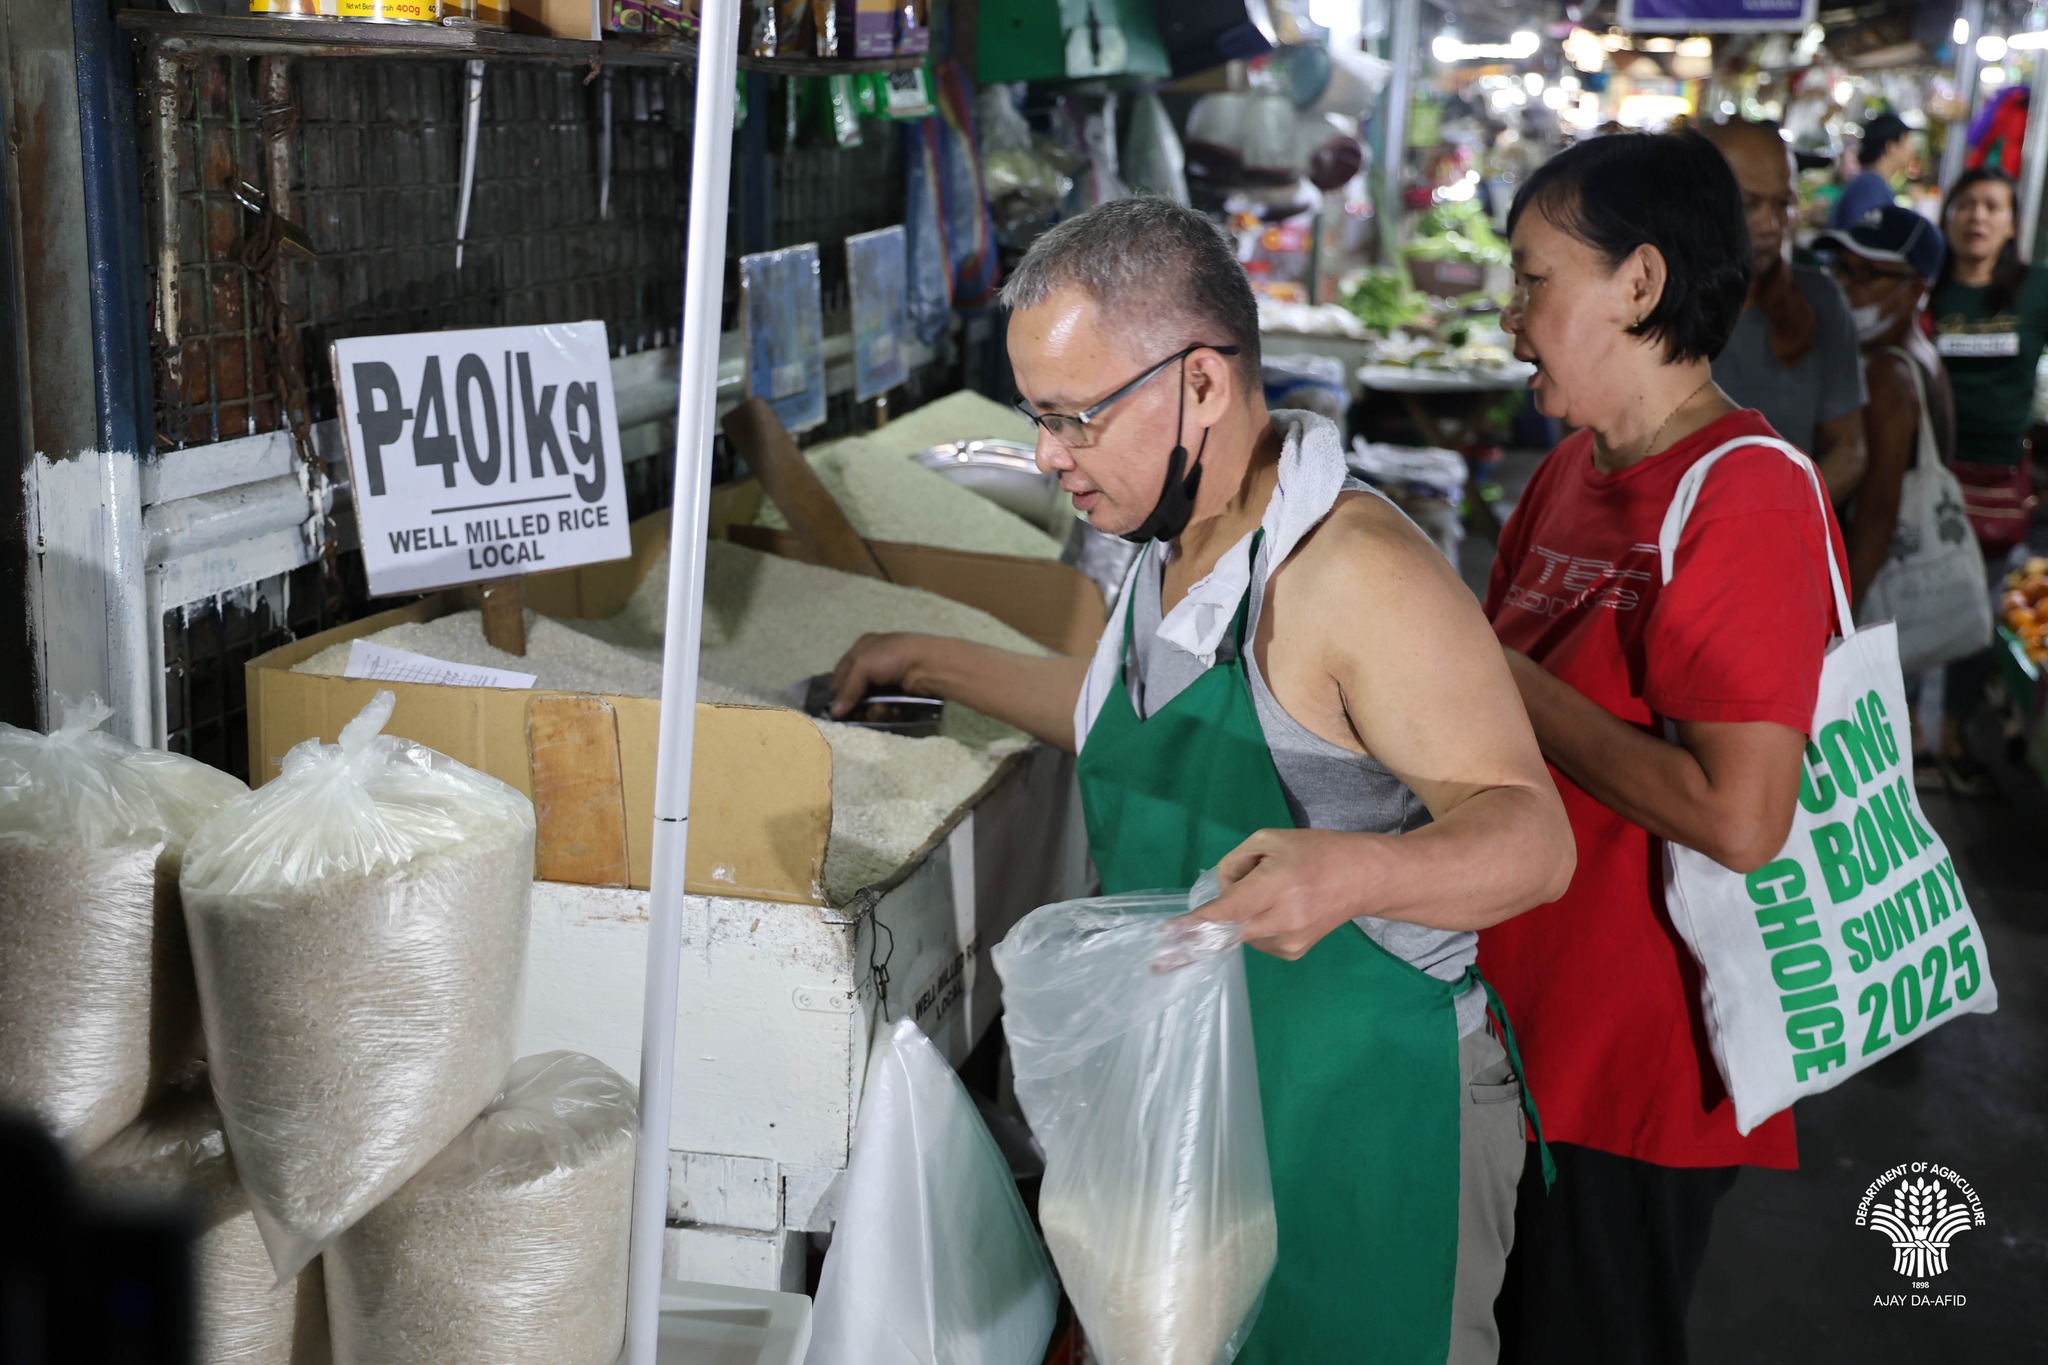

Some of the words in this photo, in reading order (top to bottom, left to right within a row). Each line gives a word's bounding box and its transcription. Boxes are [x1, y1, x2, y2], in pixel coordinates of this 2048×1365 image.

[396, 4, 420, 16] 400g
[388, 525, 457, 554] WELL
[465, 513, 550, 544] MILLED
[558, 505, 610, 533] RICE
[468, 540, 545, 570] LOCAL
[1798, 689, 1900, 814] CONG
[1745, 857, 1847, 1083] CHOICE
[1840, 856, 1963, 973] SUNTAY
[1858, 925, 1981, 1057] 2025
